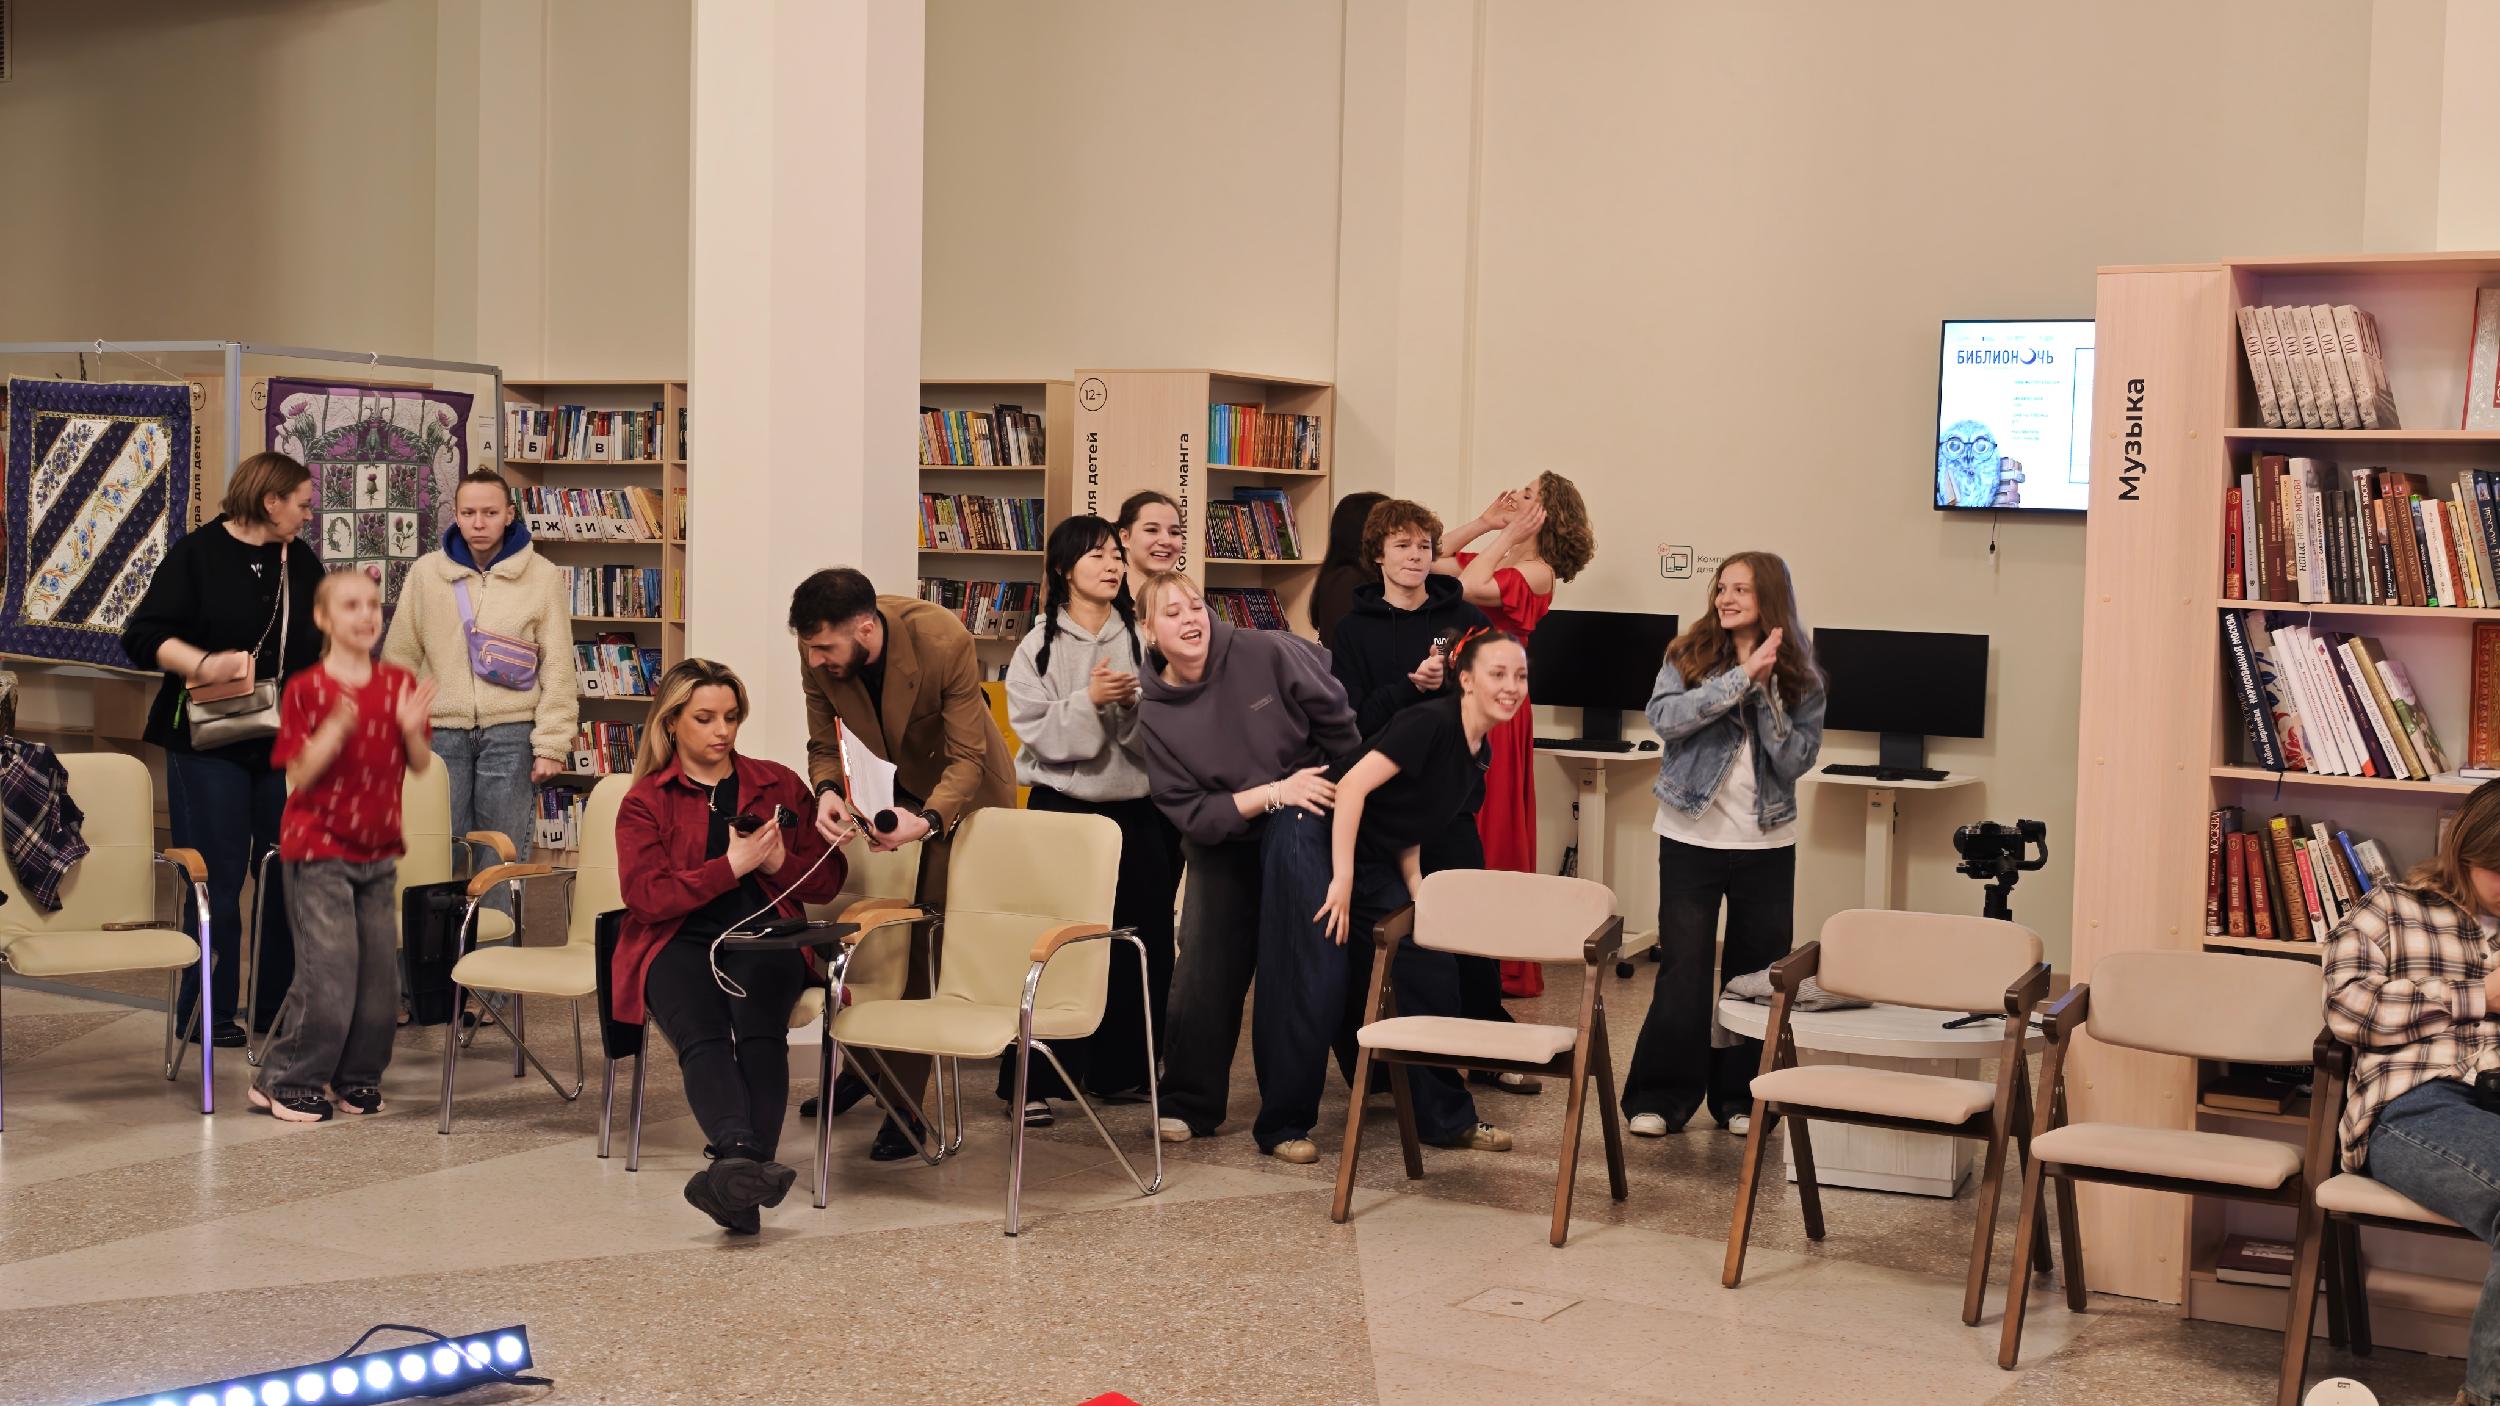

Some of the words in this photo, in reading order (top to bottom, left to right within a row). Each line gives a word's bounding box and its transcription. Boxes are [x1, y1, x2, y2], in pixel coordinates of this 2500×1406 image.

[2247, 336, 2262, 357] 100
[2266, 336, 2281, 357] 100
[2285, 336, 2300, 357] 100
[2303, 336, 2318, 357] 100
[2321, 334, 2336, 355] 100
[2342, 334, 2358, 355] 100
[254, 391, 267, 401] 12+
[1084, 389, 1103, 401] 12+
[483, 441, 492, 450] А
[2118, 378, 2147, 501] Музыка
[528, 442, 538, 452] Б
[595, 443, 605, 453] В
[1086, 432, 1099, 486] детей
[545, 521, 561, 531] Ж
[585, 522, 597, 533] И
[614, 524, 627, 534] К
[938, 531, 949, 544] Д
[1697, 555, 1725, 564] Комп
[987, 618, 998, 629] Н
[1005, 618, 1015, 629] О
[2225, 612, 2242, 645] МОСКВА
[2233, 645, 2259, 705] НАРИСОВАННАЯ
[587, 679, 598, 690] О
[579, 757, 590, 767] С
[2210, 811, 2221, 854] МОСКВА
